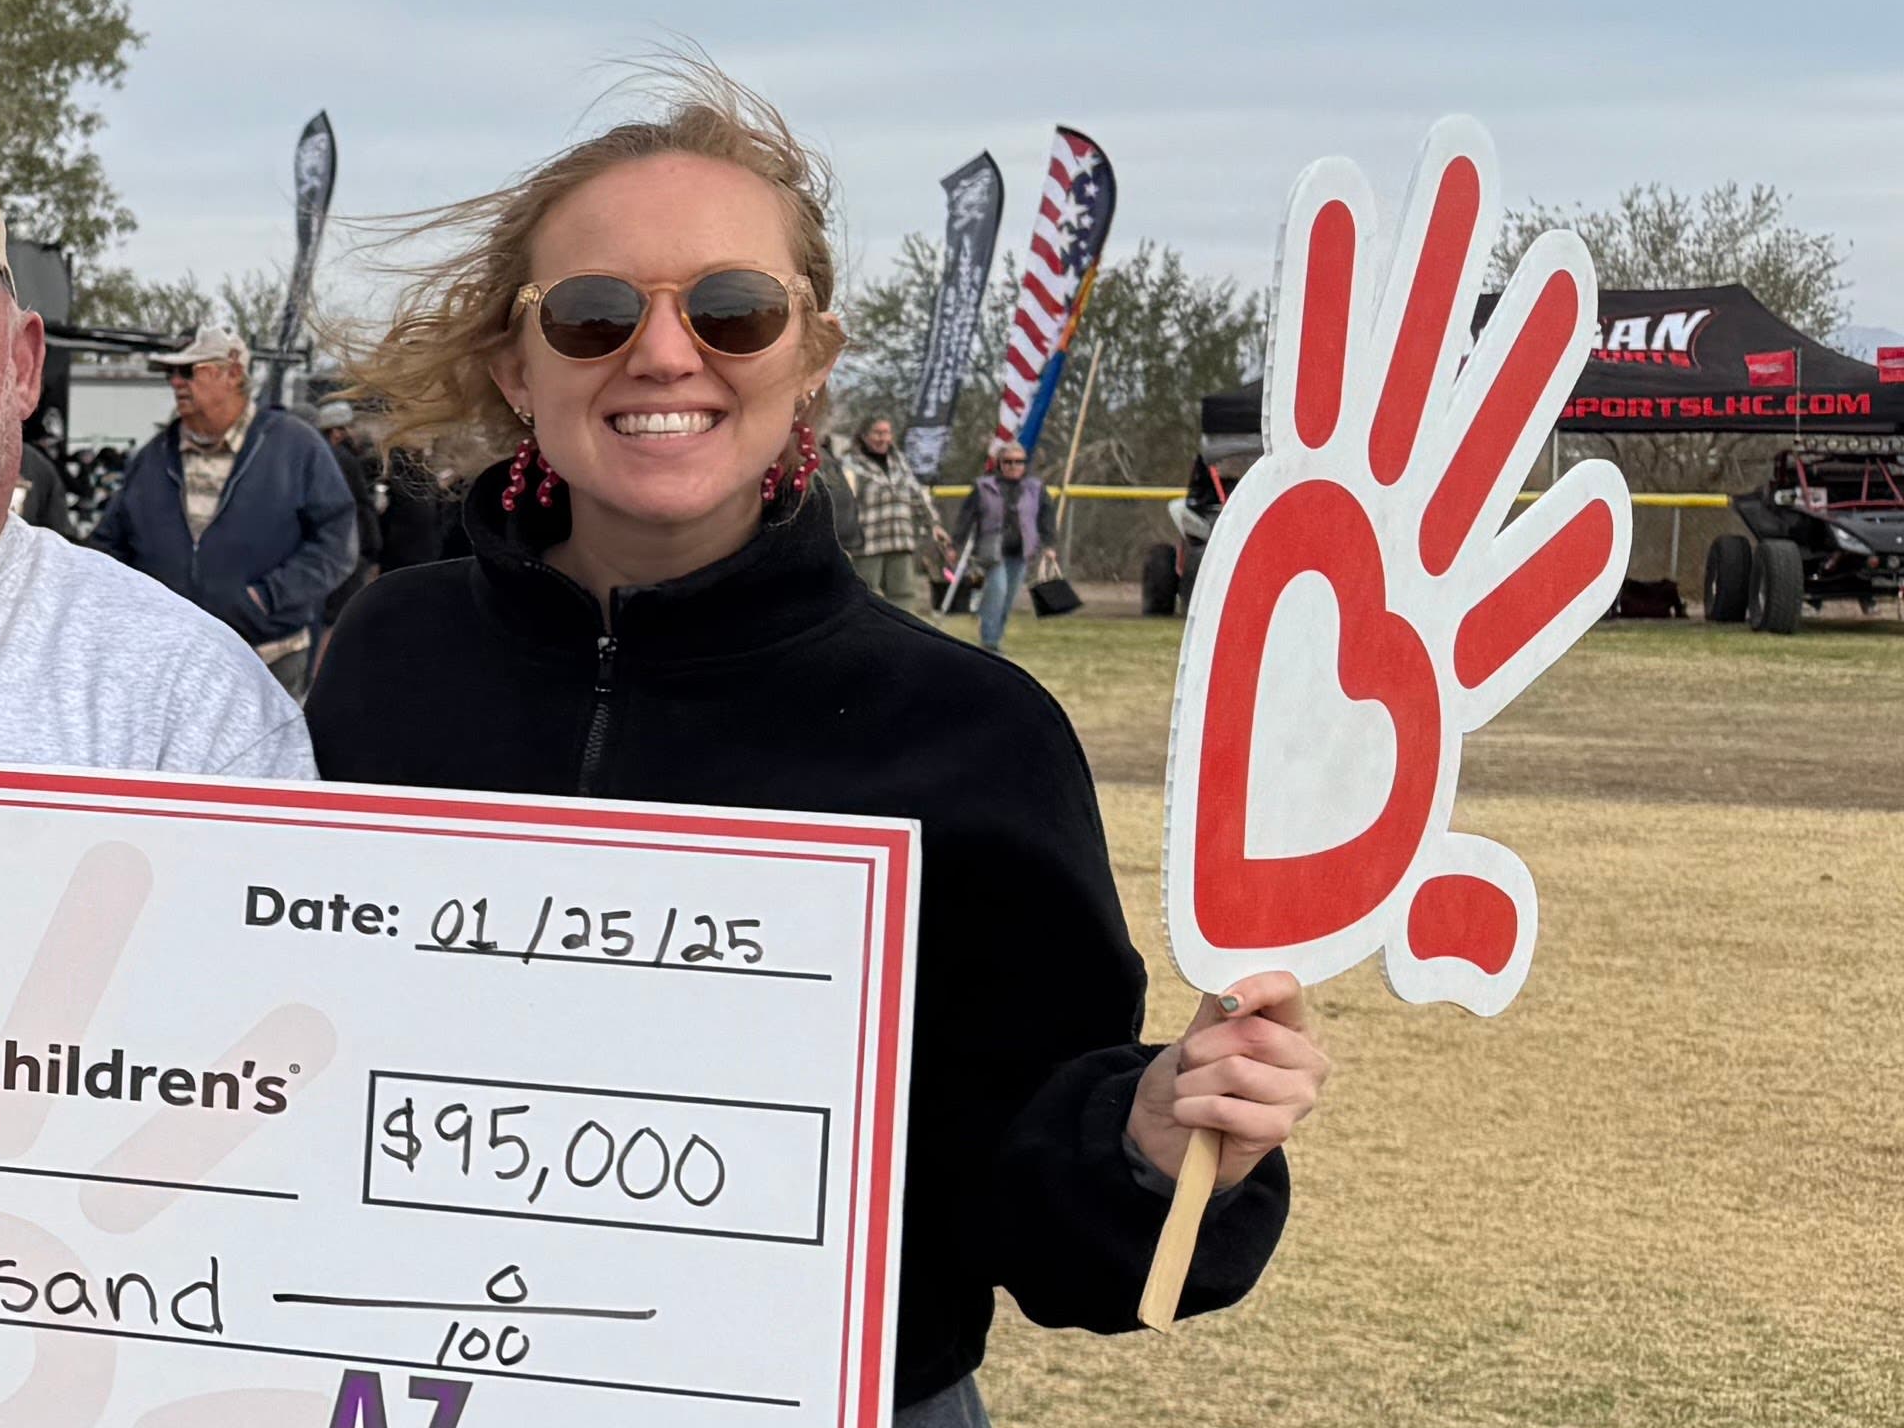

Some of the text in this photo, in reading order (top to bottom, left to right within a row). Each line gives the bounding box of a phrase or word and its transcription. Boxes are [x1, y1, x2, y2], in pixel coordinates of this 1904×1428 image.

[245, 885, 400, 937] Date:
[380, 1097, 726, 1208] $95,000
[436, 1321, 530, 1368] 100
